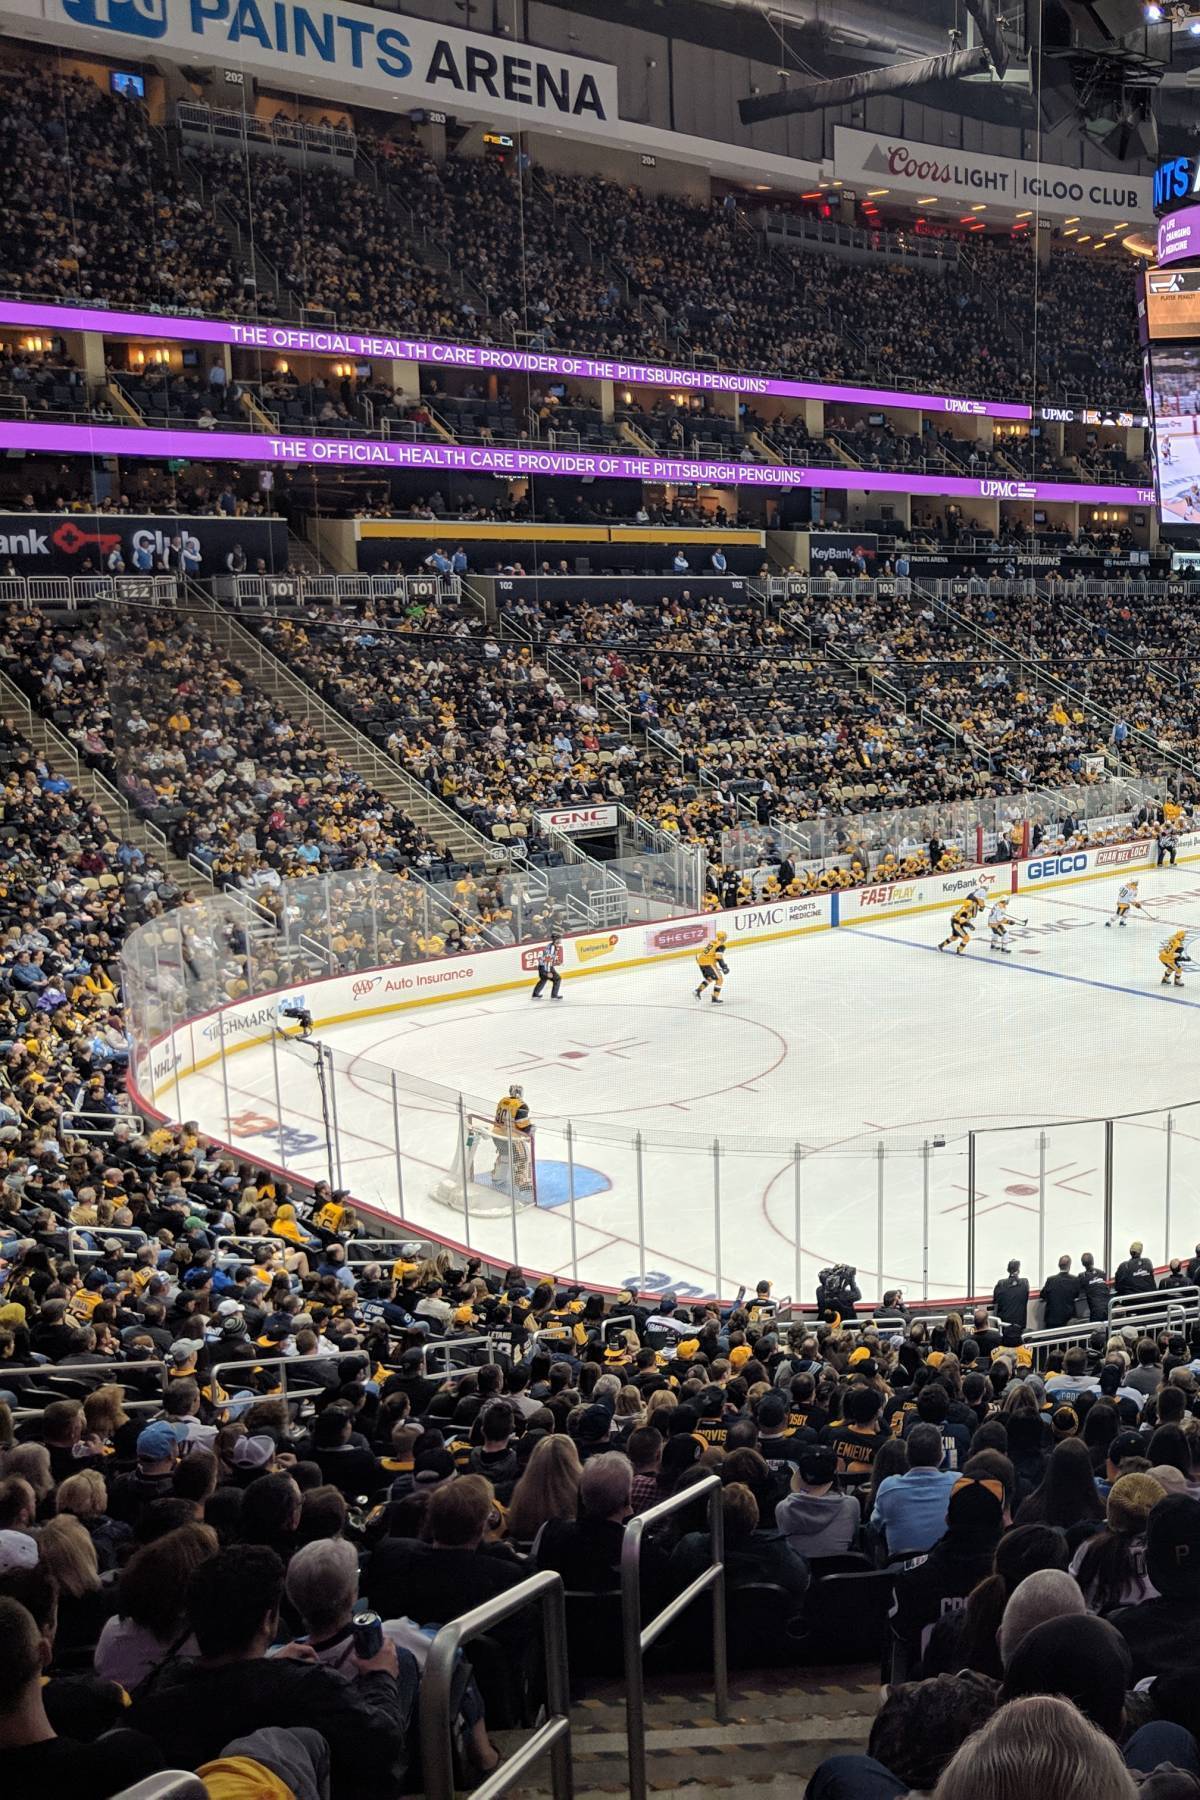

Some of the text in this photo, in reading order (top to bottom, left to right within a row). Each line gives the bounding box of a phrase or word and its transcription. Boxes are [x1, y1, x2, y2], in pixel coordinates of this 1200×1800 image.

[190, 0, 607, 121] PAINTS ARENA
[225, 71, 244, 84] 202
[430, 111, 446, 123] 203
[888, 146, 1138, 208] Coors LIGHT IGLOO CLUB
[230, 327, 700, 387] THE OFFICIAL HEALTH CARE PROVIDER OF THE PITTSBURGH
[945, 401, 973, 412] UPMC
[1042, 409, 1073, 421] UPMC
[270, 440, 736, 480] THE OFFICIAL HEALTH CARE PROVIDER OF THE PITTSBURGH
[980, 481, 1017, 498] UPMC
[811, 548, 854, 562] KeyBank
[1017, 556, 1061, 565] PENGUINS
[271, 583, 294, 596] 101
[413, 583, 432, 595] 101
[500, 581, 513, 590] 102
[732, 581, 743, 589] 102
[791, 584, 807, 594] 103
[879, 583, 894, 593] 103
[954, 584, 968, 594] 104
[1169, 585, 1184, 594] 104
[551, 810, 608, 825] GNC
[1027, 854, 1087, 879] GEICO
[943, 878, 977, 892] KeyBank
[789, 903, 816, 914] SPORTS
[789, 909, 822, 921] MEDICINE
[735, 909, 783, 930] UPMC
[658, 929, 704, 944] SHEETZ
[353, 970, 473, 995] AAA Auto Insurance
[833, 1439, 873, 1462] LEMIEUX
